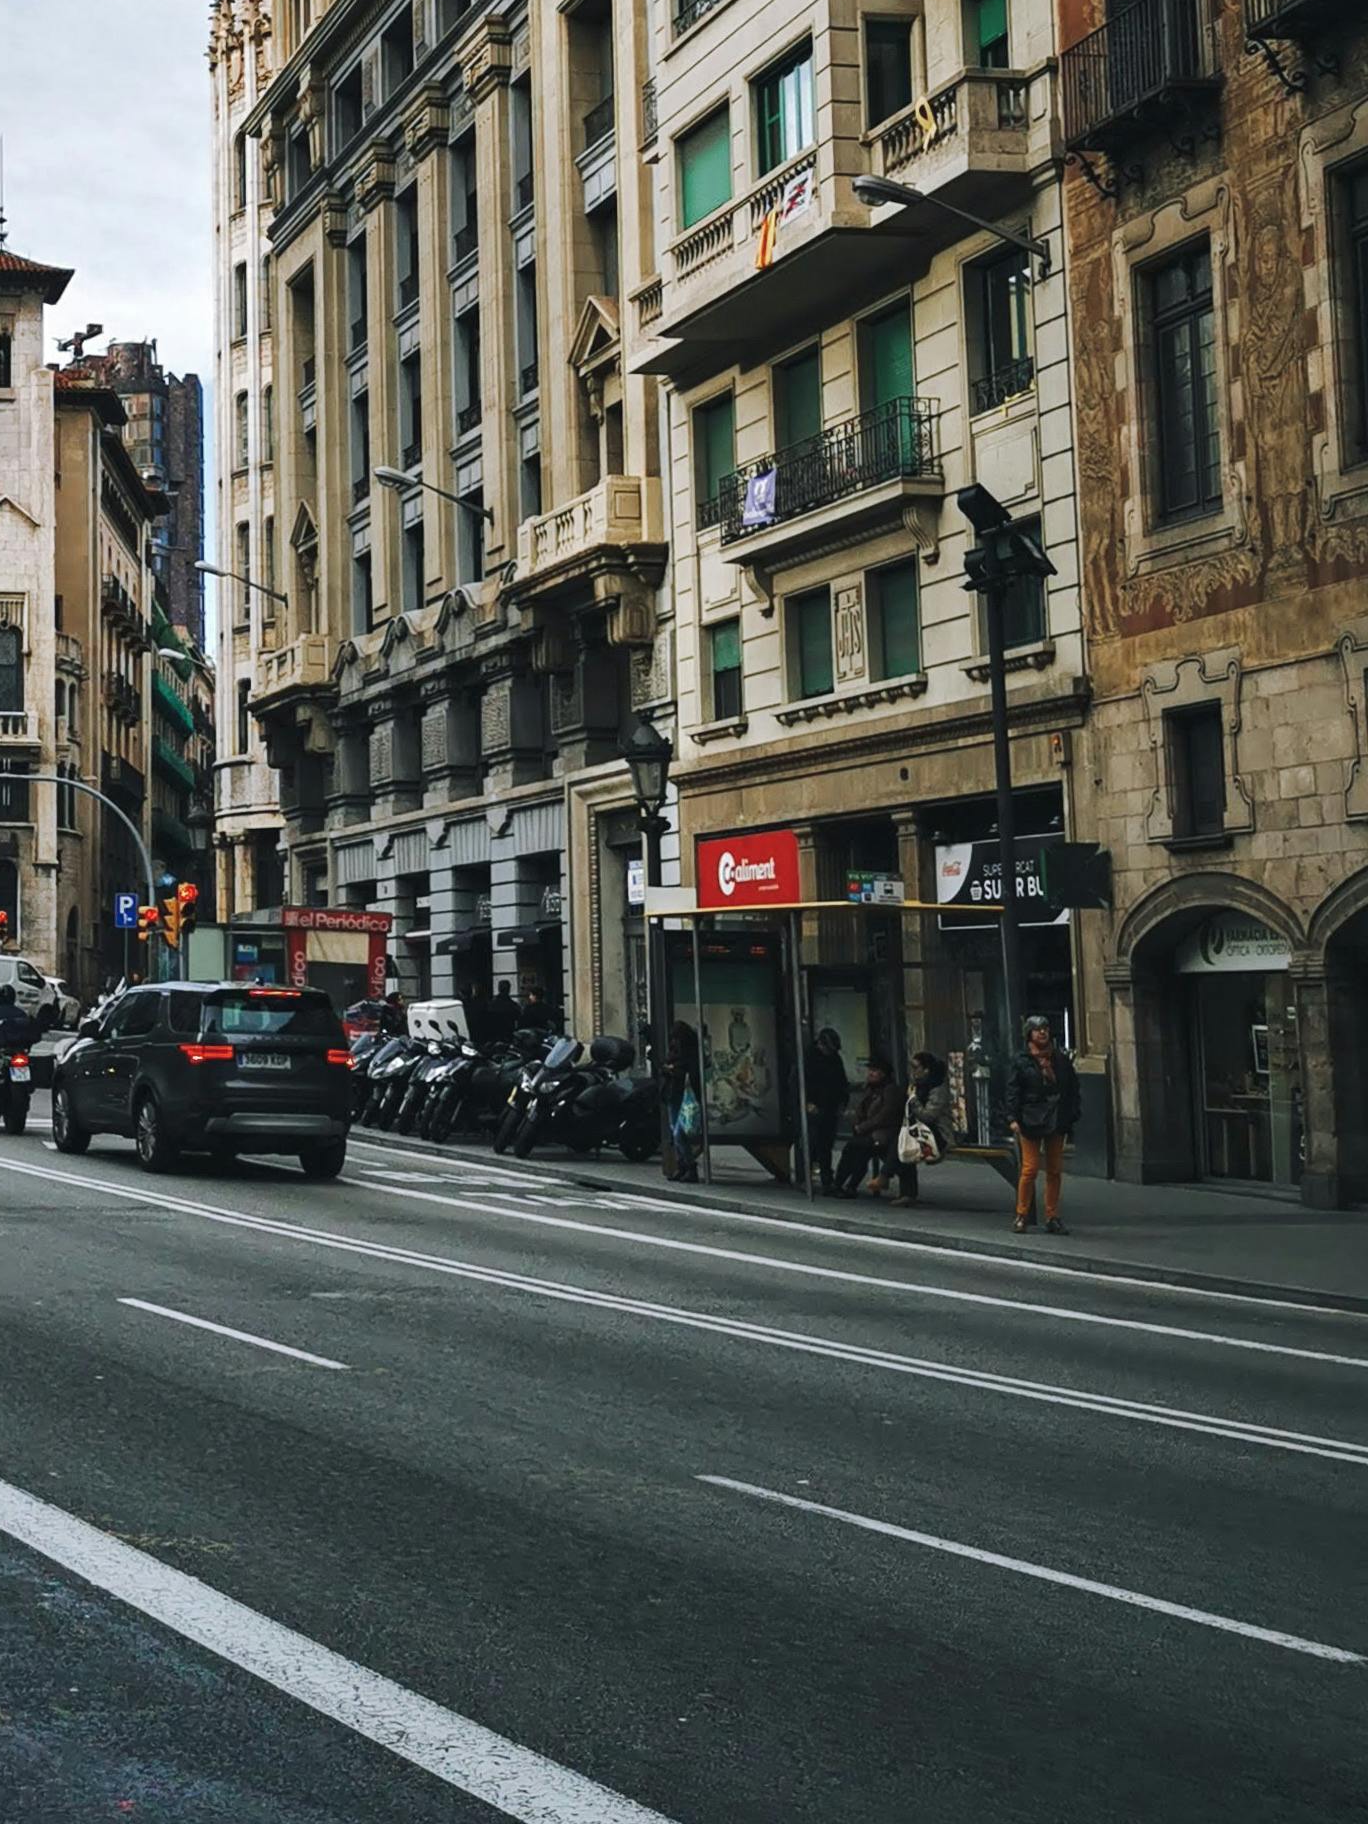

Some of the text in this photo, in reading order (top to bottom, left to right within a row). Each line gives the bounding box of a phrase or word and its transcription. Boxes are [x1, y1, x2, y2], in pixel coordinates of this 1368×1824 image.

[119, 896, 134, 914] P
[299, 912, 389, 932] el Periódico
